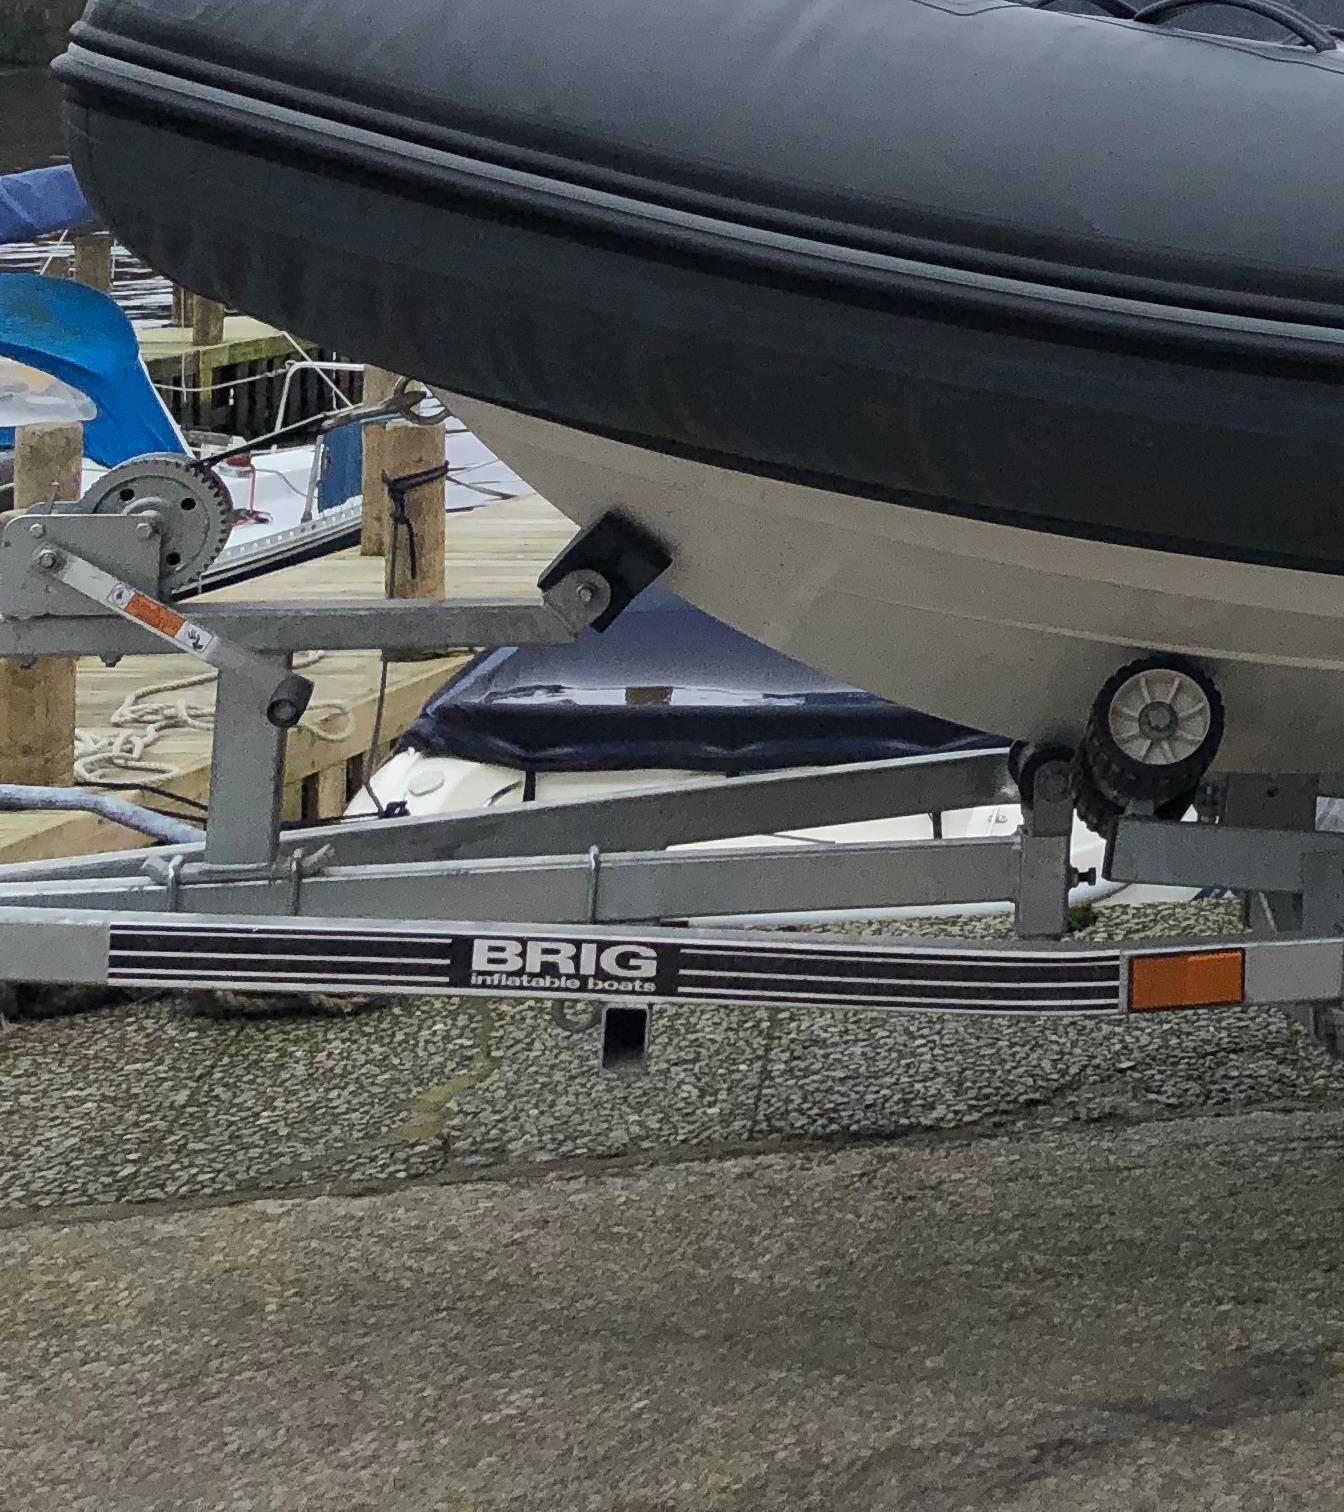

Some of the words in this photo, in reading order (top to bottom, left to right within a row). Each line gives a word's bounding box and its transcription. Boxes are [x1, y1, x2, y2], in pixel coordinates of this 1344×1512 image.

[471, 938, 658, 978] BRIG
[470, 972, 581, 990] inflatable
[587, 977, 657, 993] boats
